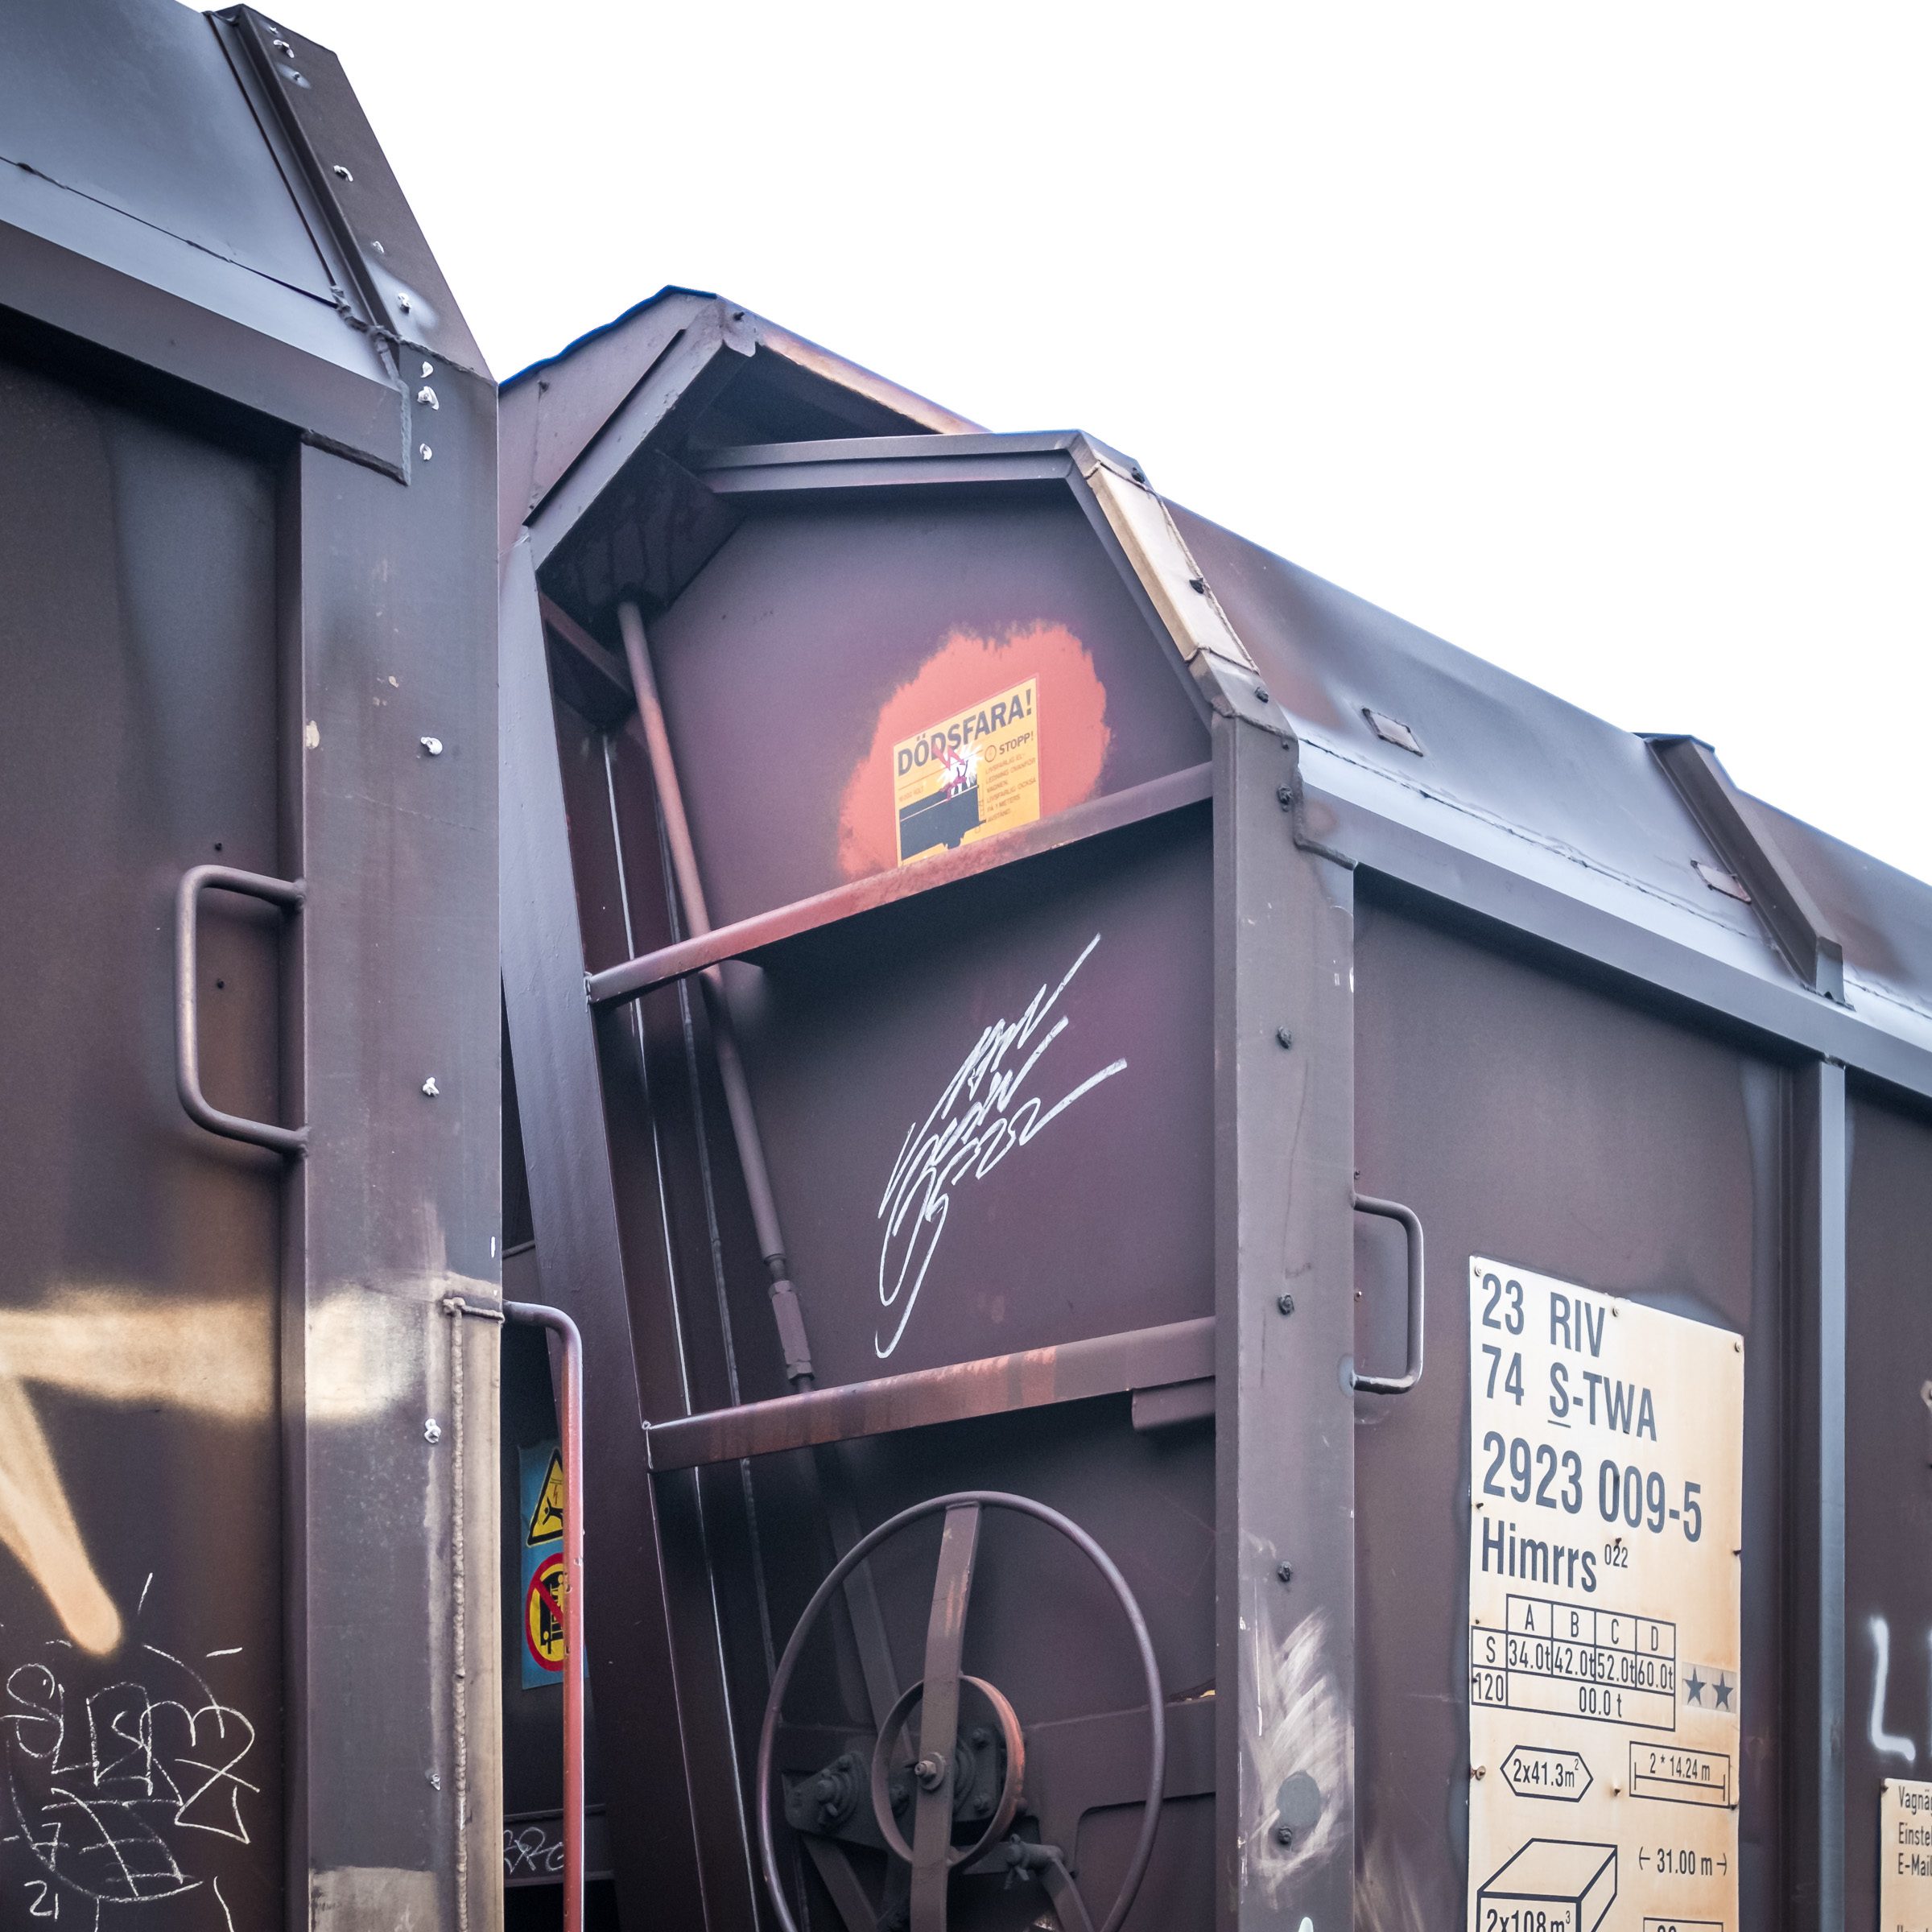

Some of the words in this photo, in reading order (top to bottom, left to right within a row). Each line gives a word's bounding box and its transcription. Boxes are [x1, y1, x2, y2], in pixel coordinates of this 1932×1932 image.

[898, 688, 1032, 777] DÖDSFARA!
[999, 730, 1034, 755] STOPP!
[1482, 1273, 1525, 1335] 23
[1550, 1291, 1606, 1358] RIV
[1482, 1343, 1525, 1406] 74
[1547, 1361, 1657, 1443] S-TWA
[1483, 1430, 1583, 1514] 2923
[1599, 1459, 1703, 1543] 009-5
[1481, 1517, 1597, 1593] Himrrs
[1604, 1543, 1629, 1569] 022
[1525, 1604, 1535, 1632] A
[1571, 1611, 1579, 1638] B
[1611, 1618, 1620, 1645] C
[1651, 1625, 1659, 1652] D
[1476, 1671, 1504, 1703] 120
[1579, 1686, 1611, 1716] 00.0
[1486, 1636, 1496, 1664] S
[1509, 1638, 1551, 1671] 34.0t
[1554, 1645, 1596, 1678] 42.0t
[1598, 1653, 1636, 1683] 52.0t
[1637, 1660, 1674, 1690] 60.0t
[1657, 1849, 1695, 1876] 31.00
[1701, 1857, 1713, 1876] m
